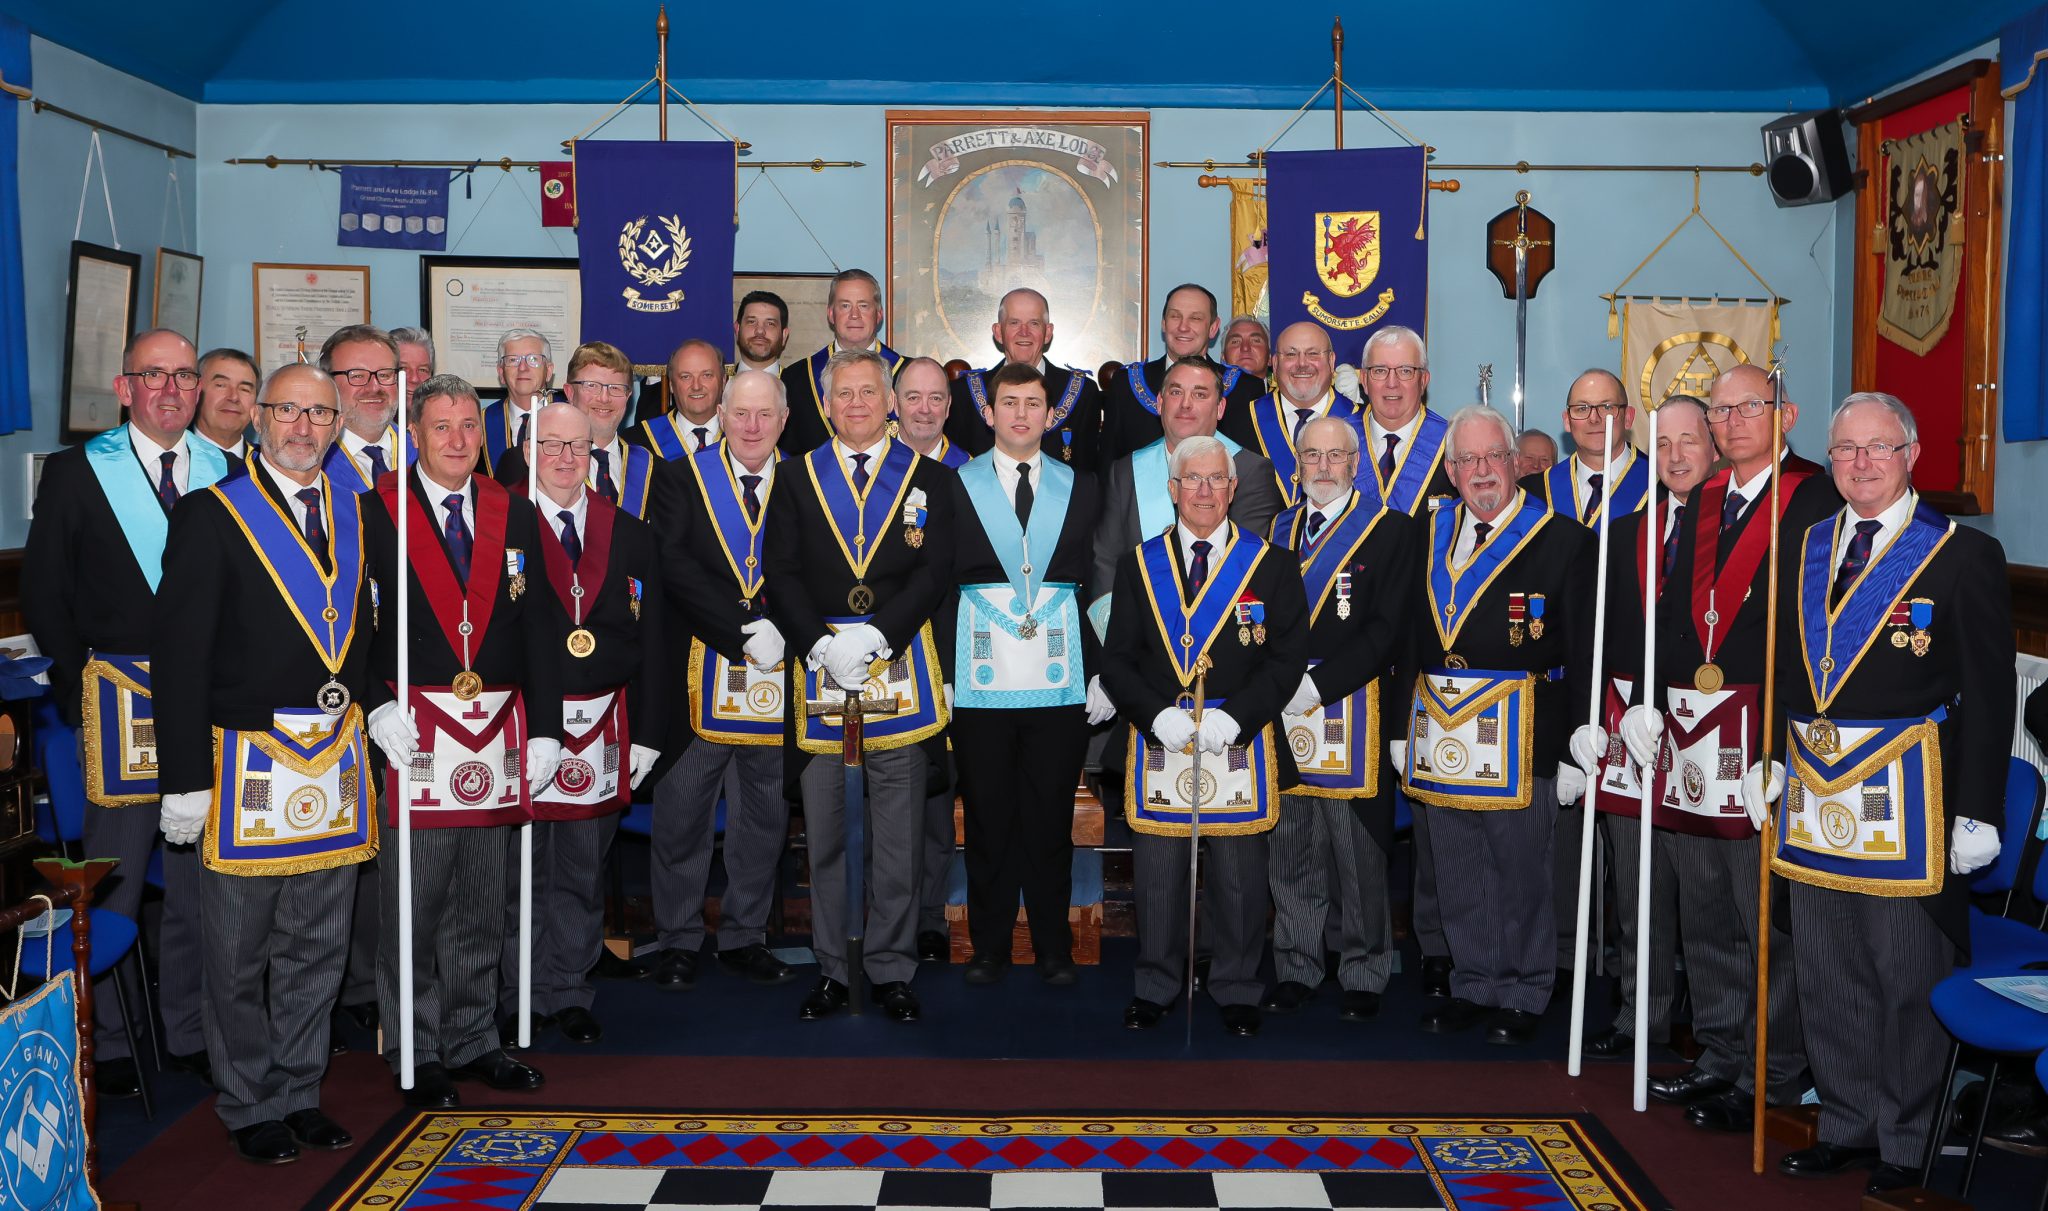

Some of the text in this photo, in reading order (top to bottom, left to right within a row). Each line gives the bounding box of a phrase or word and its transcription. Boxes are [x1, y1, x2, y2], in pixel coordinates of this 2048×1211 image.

[934, 130, 1105, 164] PARRETT & AXE LODGE
[400, 187, 419, 196] Lodge
[632, 300, 674, 310] SOMERSET
[1363, 305, 1385, 324] EALLE
[455, 765, 491, 782] SOMERSET
[24, 1045, 59, 1070] GAND
